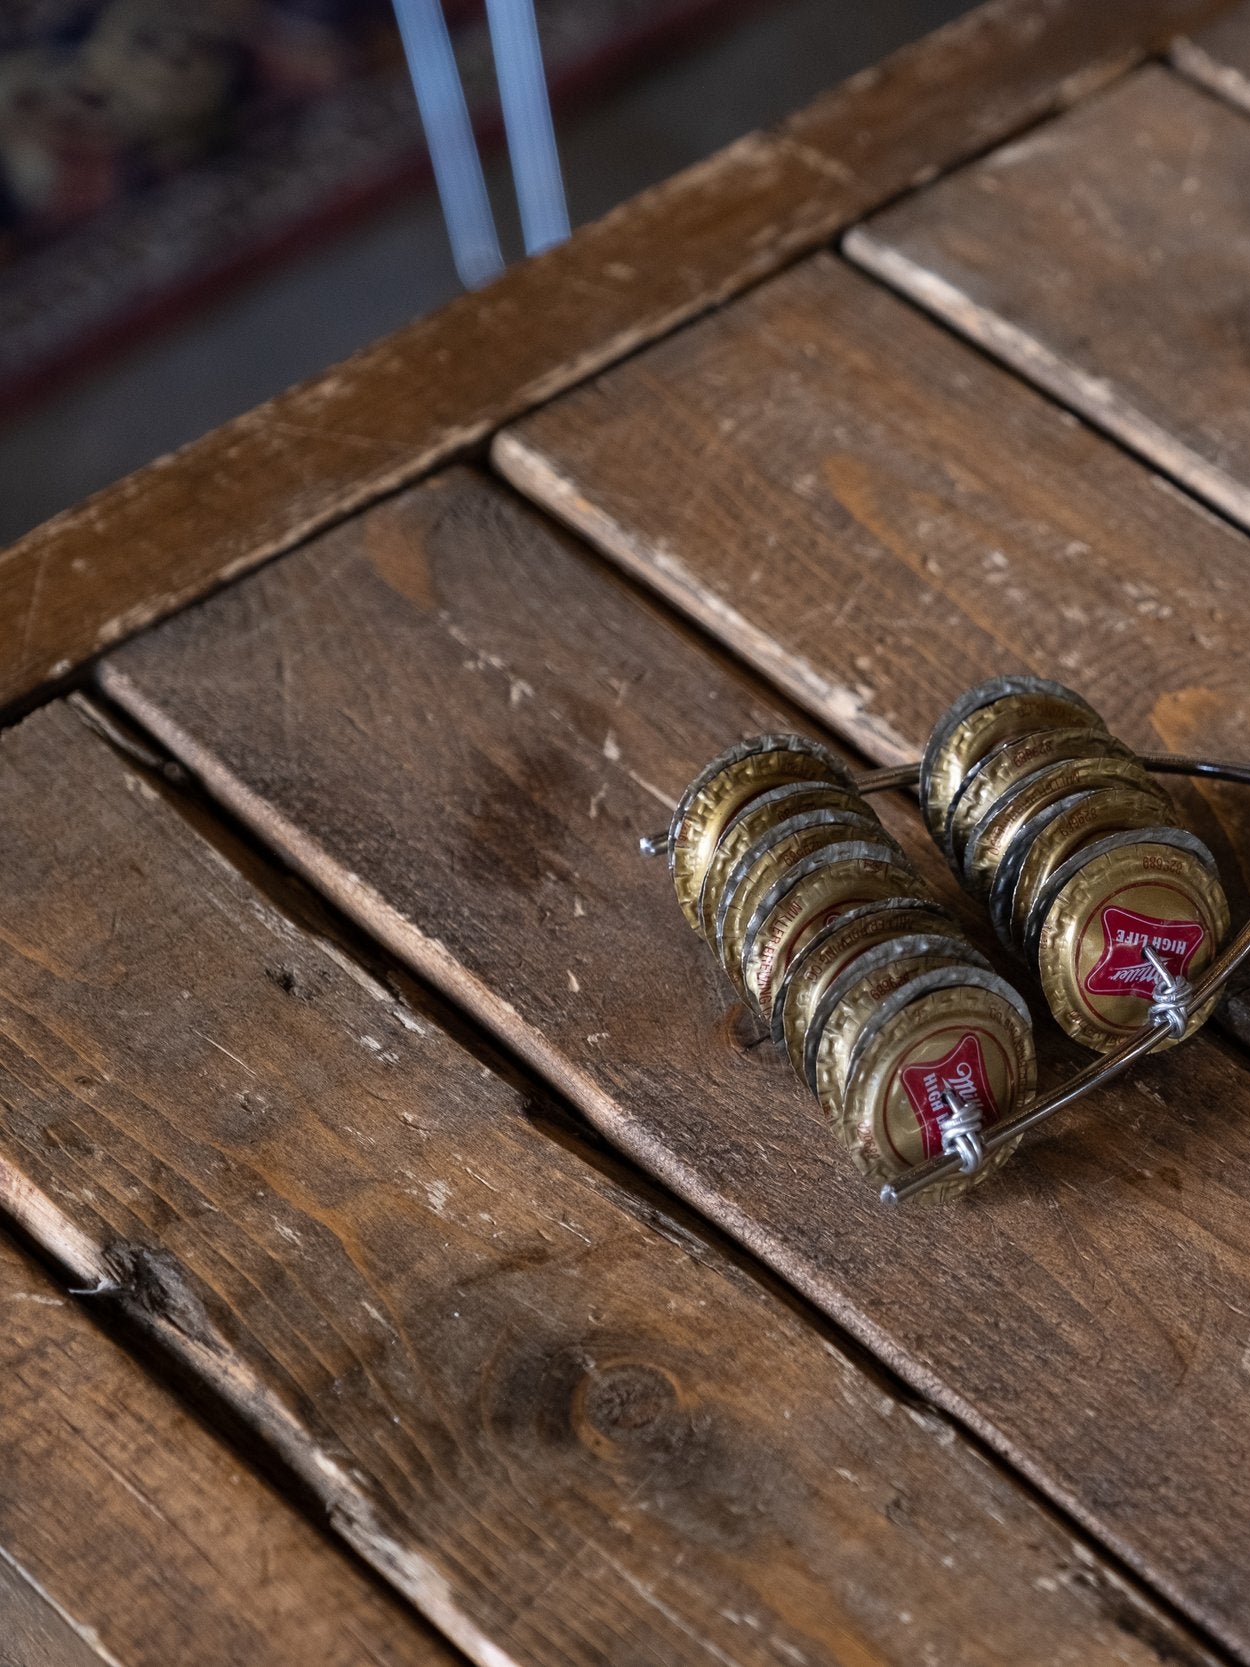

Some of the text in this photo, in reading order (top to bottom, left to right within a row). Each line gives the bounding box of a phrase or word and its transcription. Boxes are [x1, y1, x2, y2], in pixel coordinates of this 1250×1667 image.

[772, 901, 802, 944] MILLER
[1115, 929, 1187, 955] HIGH LIFE
[922, 1072, 945, 1112] HIGH
